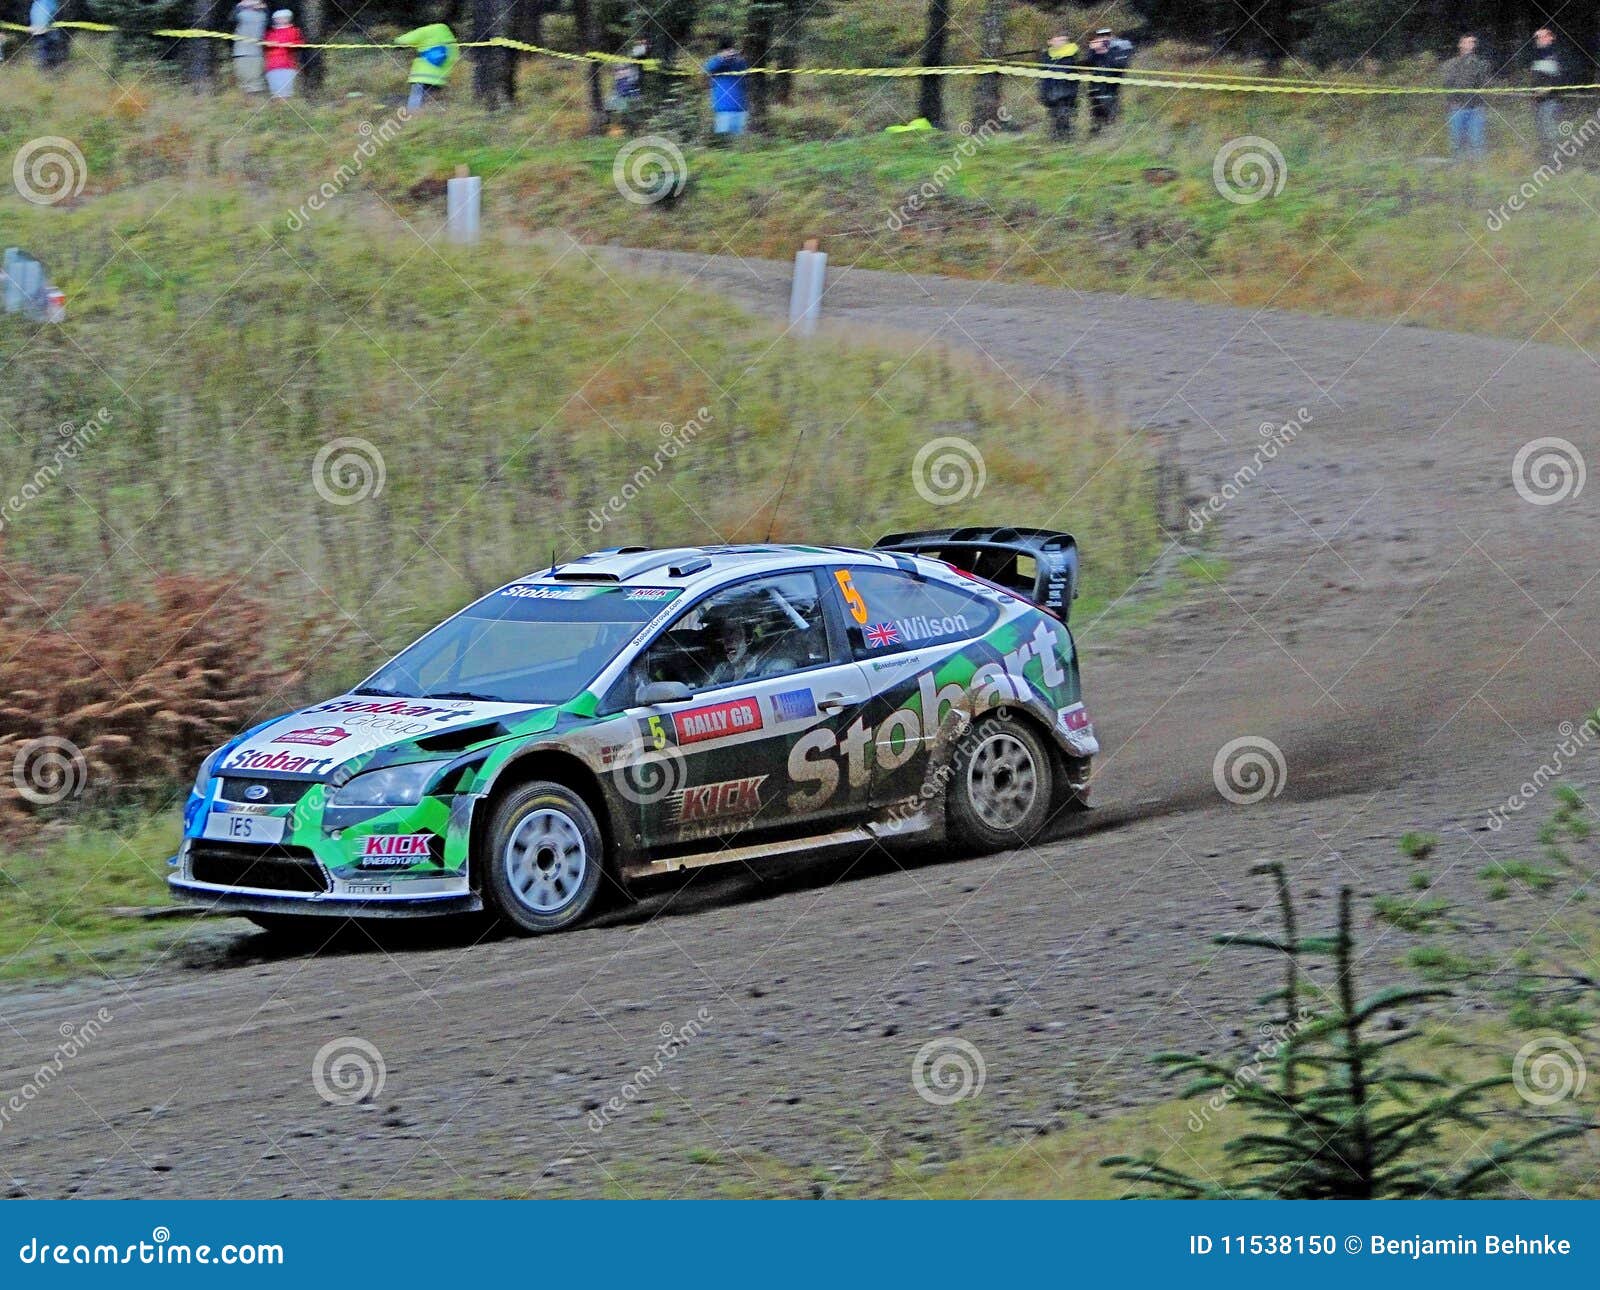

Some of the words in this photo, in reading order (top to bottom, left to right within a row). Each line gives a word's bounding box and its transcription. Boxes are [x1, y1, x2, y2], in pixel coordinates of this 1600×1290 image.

[834, 568, 868, 624] 5
[632, 598, 682, 647] StobartGroup.com
[896, 614, 969, 641] Wilson
[301, 700, 475, 722] Stobart
[342, 713, 429, 735] Group
[683, 709, 729, 736] RALLY
[731, 705, 754, 728] GB
[786, 619, 1065, 811] Stobart
[648, 715, 667, 750] 5
[227, 748, 334, 774] Stobart
[681, 776, 768, 824] KICK
[366, 834, 433, 855] KICK
